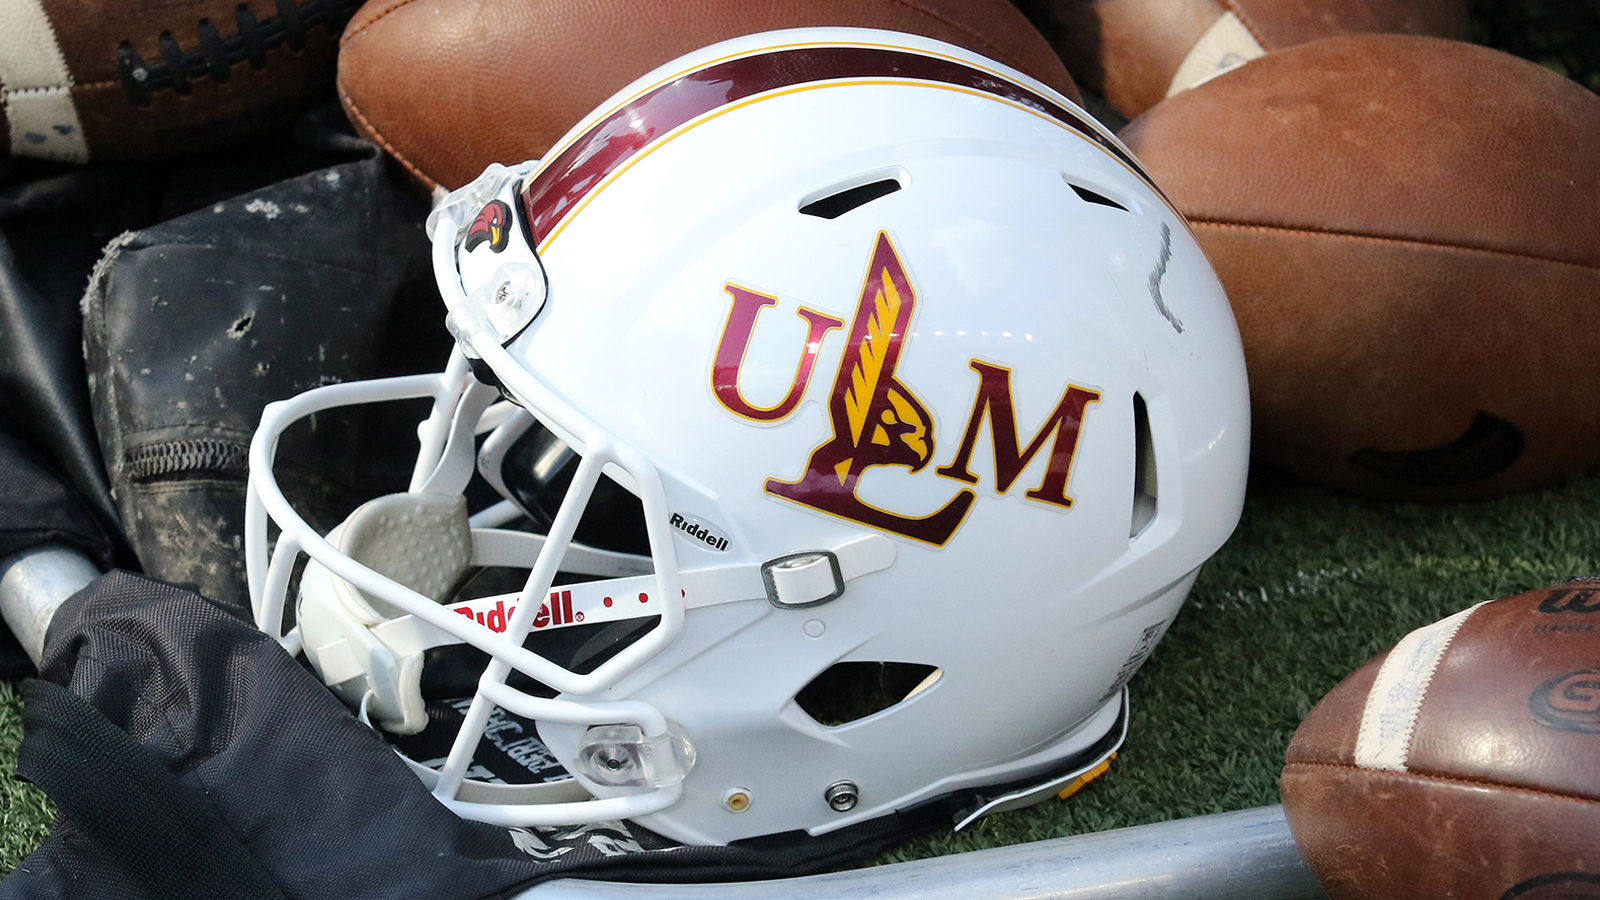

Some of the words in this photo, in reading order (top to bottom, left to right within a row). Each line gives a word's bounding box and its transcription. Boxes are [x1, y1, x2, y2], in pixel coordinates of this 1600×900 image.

[711, 229, 1101, 547] ULM
[669, 512, 729, 551] Riddell
[453, 590, 574, 633] idell
